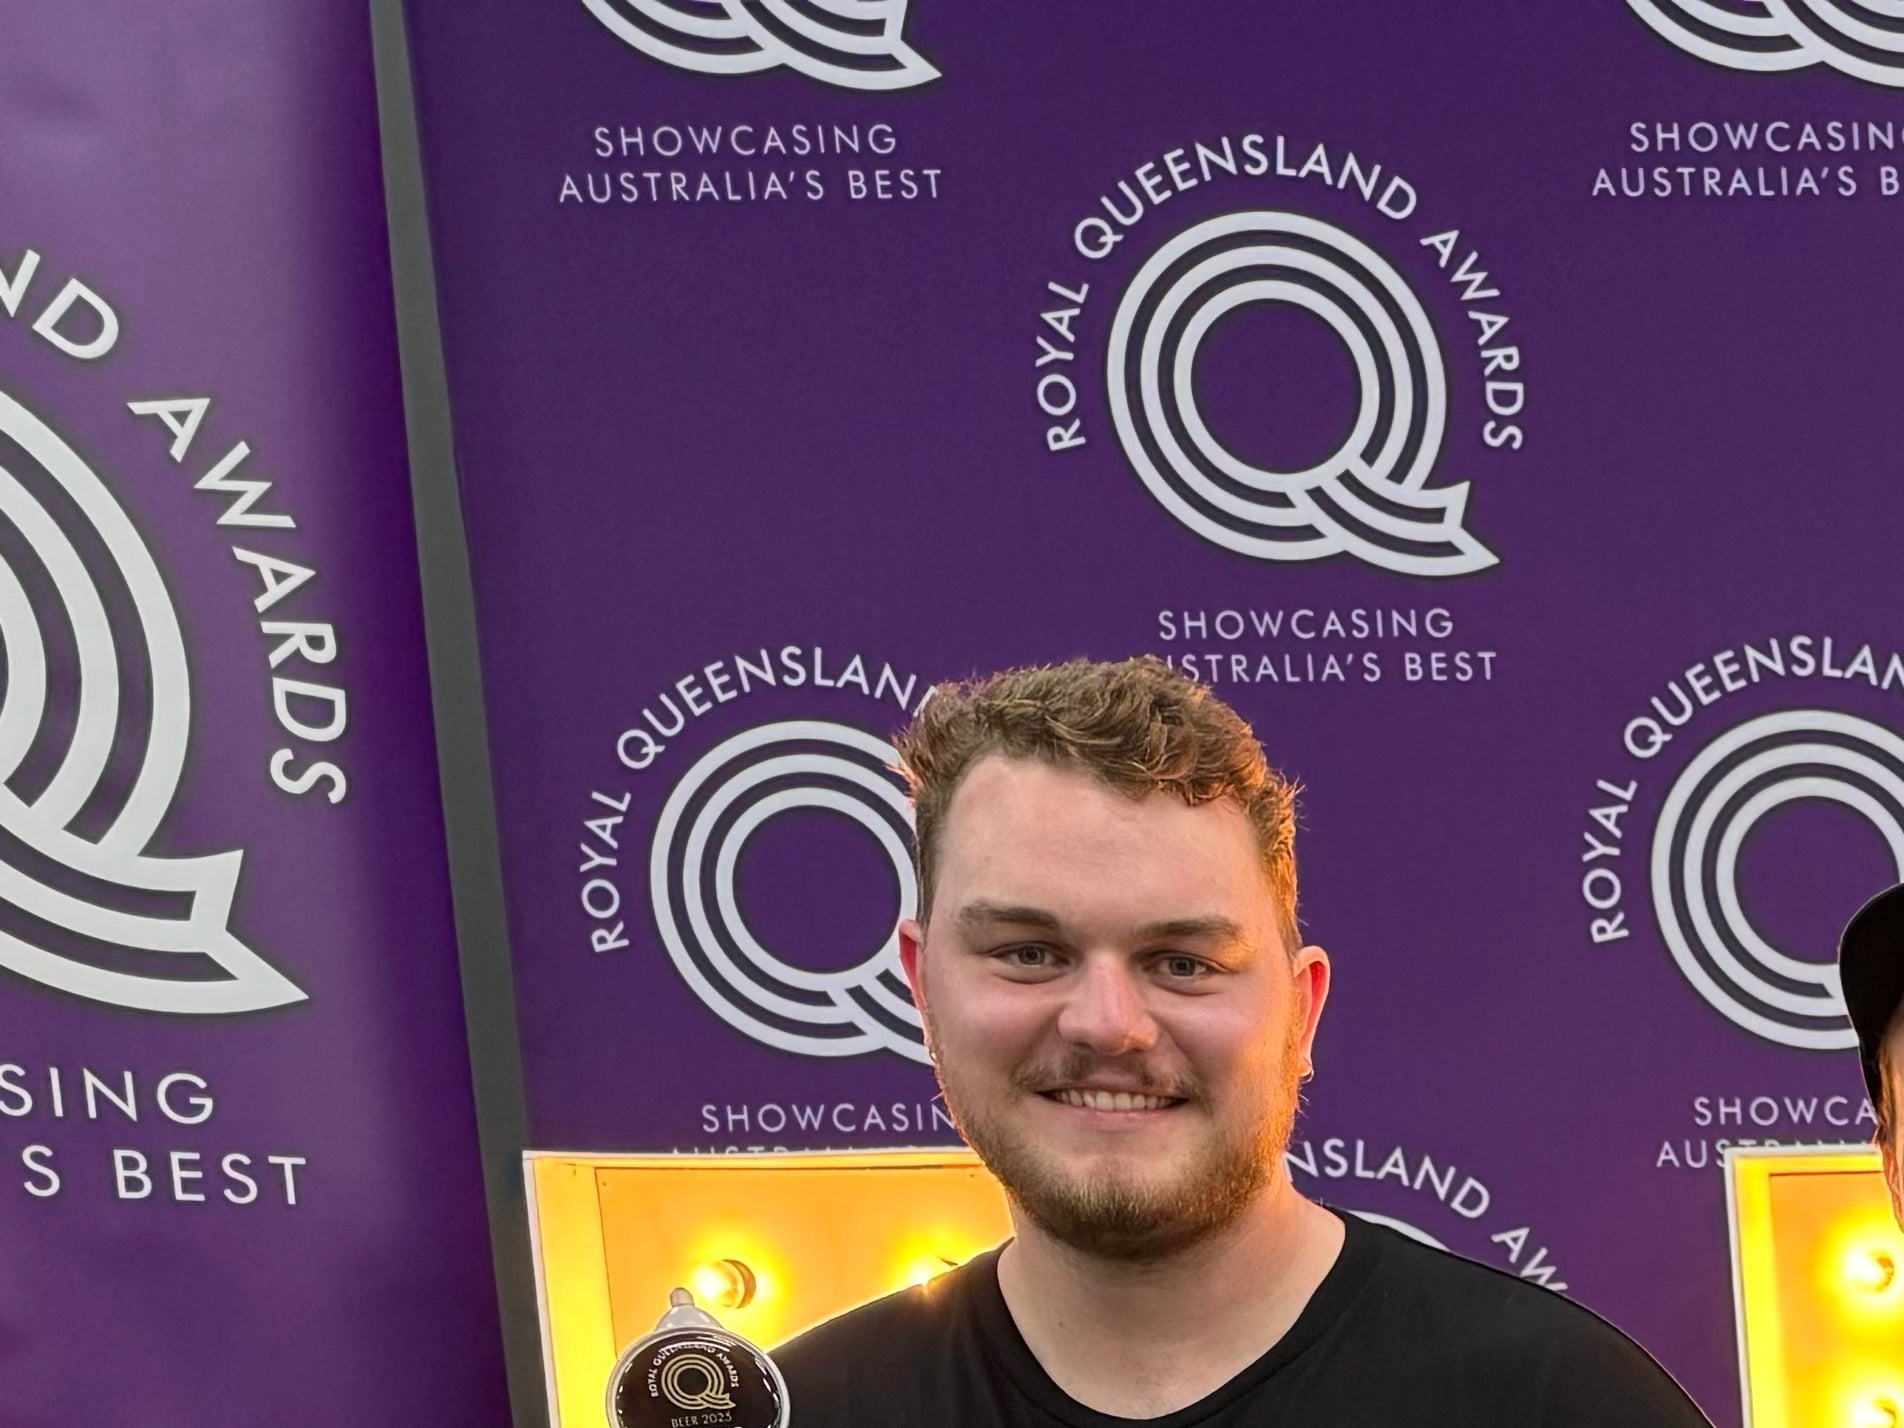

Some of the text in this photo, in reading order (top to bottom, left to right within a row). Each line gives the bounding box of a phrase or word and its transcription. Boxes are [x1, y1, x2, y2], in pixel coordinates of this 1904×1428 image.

[594, 124, 896, 157] SHOWCASING
[559, 169, 941, 203] AUSTRALIA'S BEST
[1592, 165, 1857, 197] AUSTRALIA'S
[1035, 133, 1524, 451] ROYAL QUEENSLAND AWARDS
[126, 397, 347, 804] AWARDS
[1158, 608, 1453, 641] SHOWCASING
[1166, 651, 1497, 684] STRALIA'S BEST
[579, 791, 632, 953] ROYAL
[1582, 779, 1638, 943] ROYAL
[701, 1102, 955, 1133] SHOWCASIN
[1695, 1096, 1879, 1126] SHOWCA
[113, 1149, 306, 1205] BEST
[1284, 1138, 1491, 1219] NSLAND
